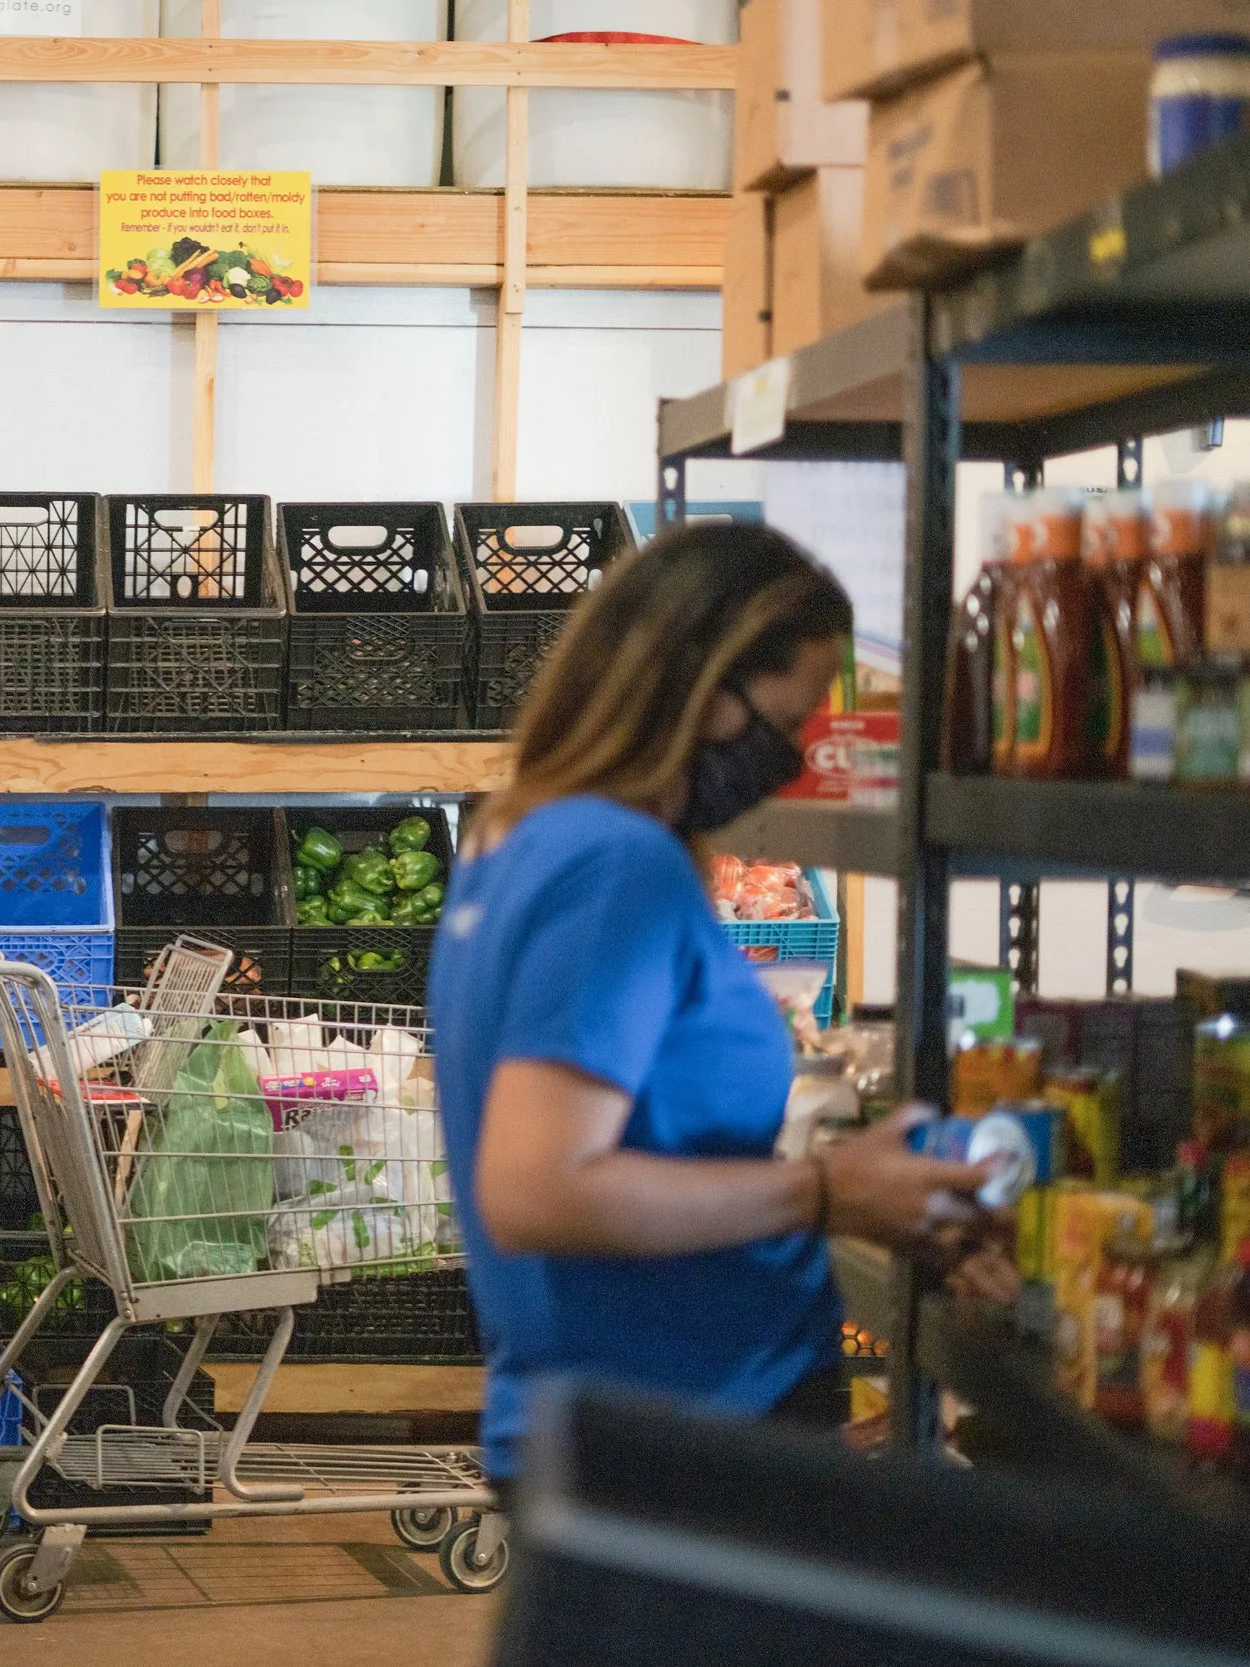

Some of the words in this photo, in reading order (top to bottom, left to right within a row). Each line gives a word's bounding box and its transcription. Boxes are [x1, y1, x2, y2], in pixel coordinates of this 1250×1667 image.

[137, 174, 171, 185] Please
[174, 174, 208, 186] watch
[210, 174, 248, 188] closely
[251, 175, 271, 186] that
[106, 192, 126, 203] you
[129, 192, 147, 201] are
[150, 191, 167, 201] not
[169, 190, 207, 204] putting
[209, 190, 305, 205] bad/rotten/moldy
[141, 207, 187, 220] produce
[189, 207, 209, 218] into
[211, 207, 236, 218] food
[239, 207, 274, 219] boxes.
[121, 222, 160, 232] Remember
[173, 225, 187, 234] you
[189, 222, 219, 233] wouldn't
[221, 223, 233, 233] eat
[242, 223, 261, 233] don't
[262, 223, 274, 235] put
